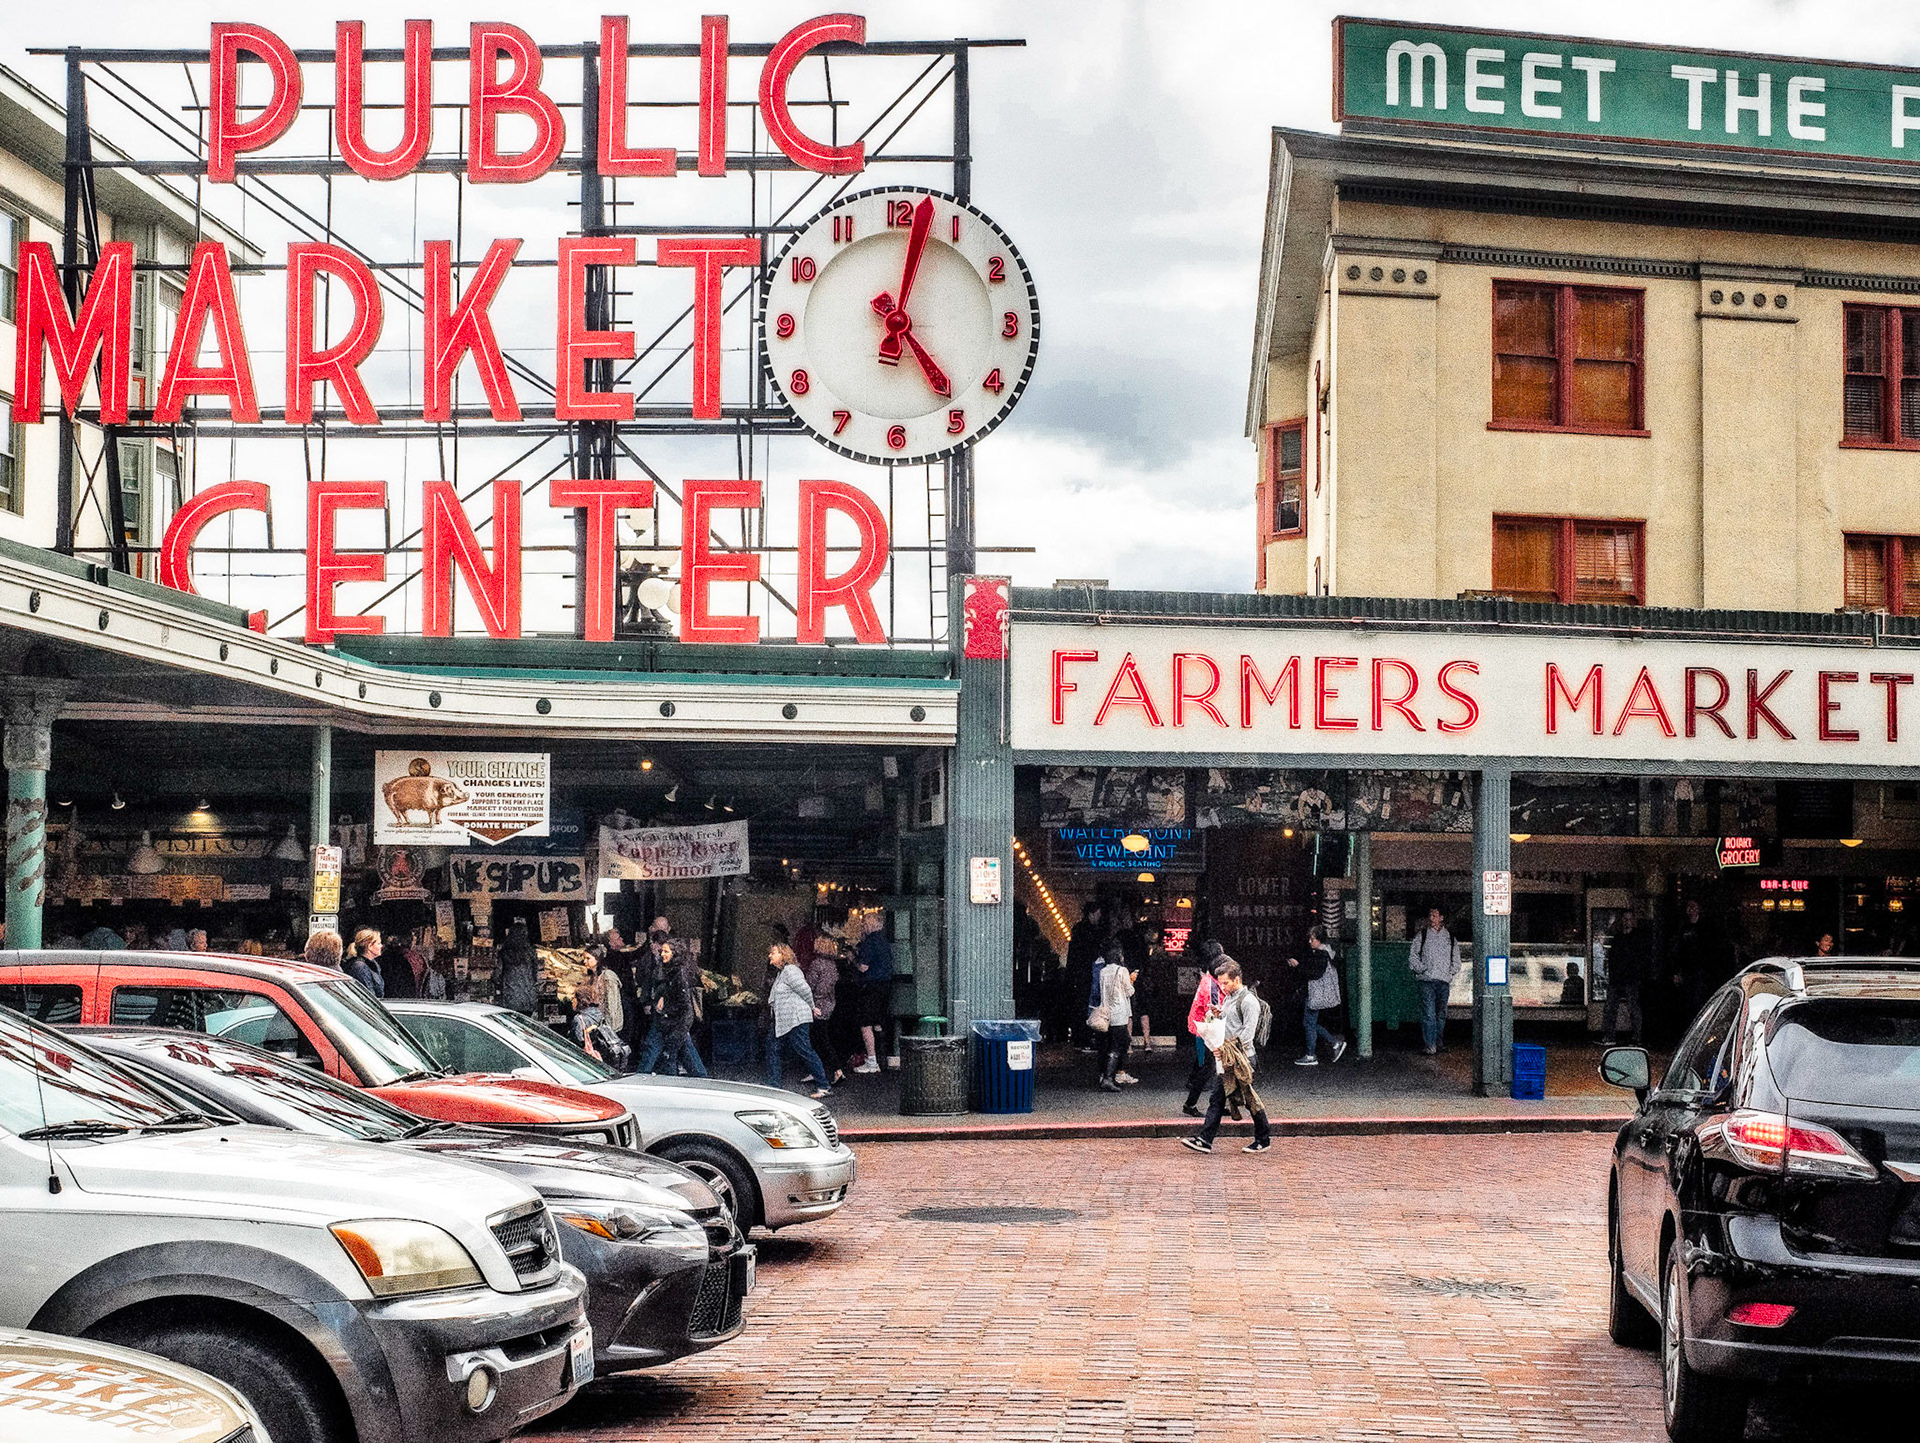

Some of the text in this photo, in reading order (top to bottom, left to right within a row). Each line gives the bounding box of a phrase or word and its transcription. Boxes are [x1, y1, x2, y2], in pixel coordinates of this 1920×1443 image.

[208, 13, 867, 185] PUBLIC
[1385, 39, 1617, 123] MEET
[1670, 64, 1827, 143] THE
[886, 199, 914, 228] 12
[833, 215, 853, 243] 11
[951, 215, 961, 242] 1
[791, 256, 817, 283] 10
[988, 255, 1006, 283] 2
[12, 237, 762, 426] MARKET
[776, 312, 796, 339] 9
[1001, 311, 1019, 338] 3
[790, 368, 810, 395] 8
[982, 367, 1005, 394] 4
[832, 410, 852, 436] 7
[946, 409, 966, 435] 5
[886, 425, 907, 450] 6
[160, 479, 889, 645] CENTER
[1052, 649, 1915, 743] FARMERS MARKET
[447, 760, 546, 780] YOUR CHANGE
[463, 779, 546, 789] CHANGES LIVES!
[475, 791, 545, 799] YOUR GENEROSITY
[471, 798, 501, 806] SUPPORTS
[463, 821, 528, 830] DONATE HERE!
[696, 828, 724, 840] Fresh
[616, 840, 741, 863] Copper River
[1098, 860, 1126, 868] PUBLIC
[1127, 860, 1162, 868] SEATING
[1720, 849, 1761, 865] GROCERY
[451, 859, 484, 893] WE
[537, 860, 583, 894] UPS
[642, 860, 713, 878] Salmon
[1237, 877, 1291, 896] LOWER
[1760, 879, 1810, 890] BAR-B-QUE
